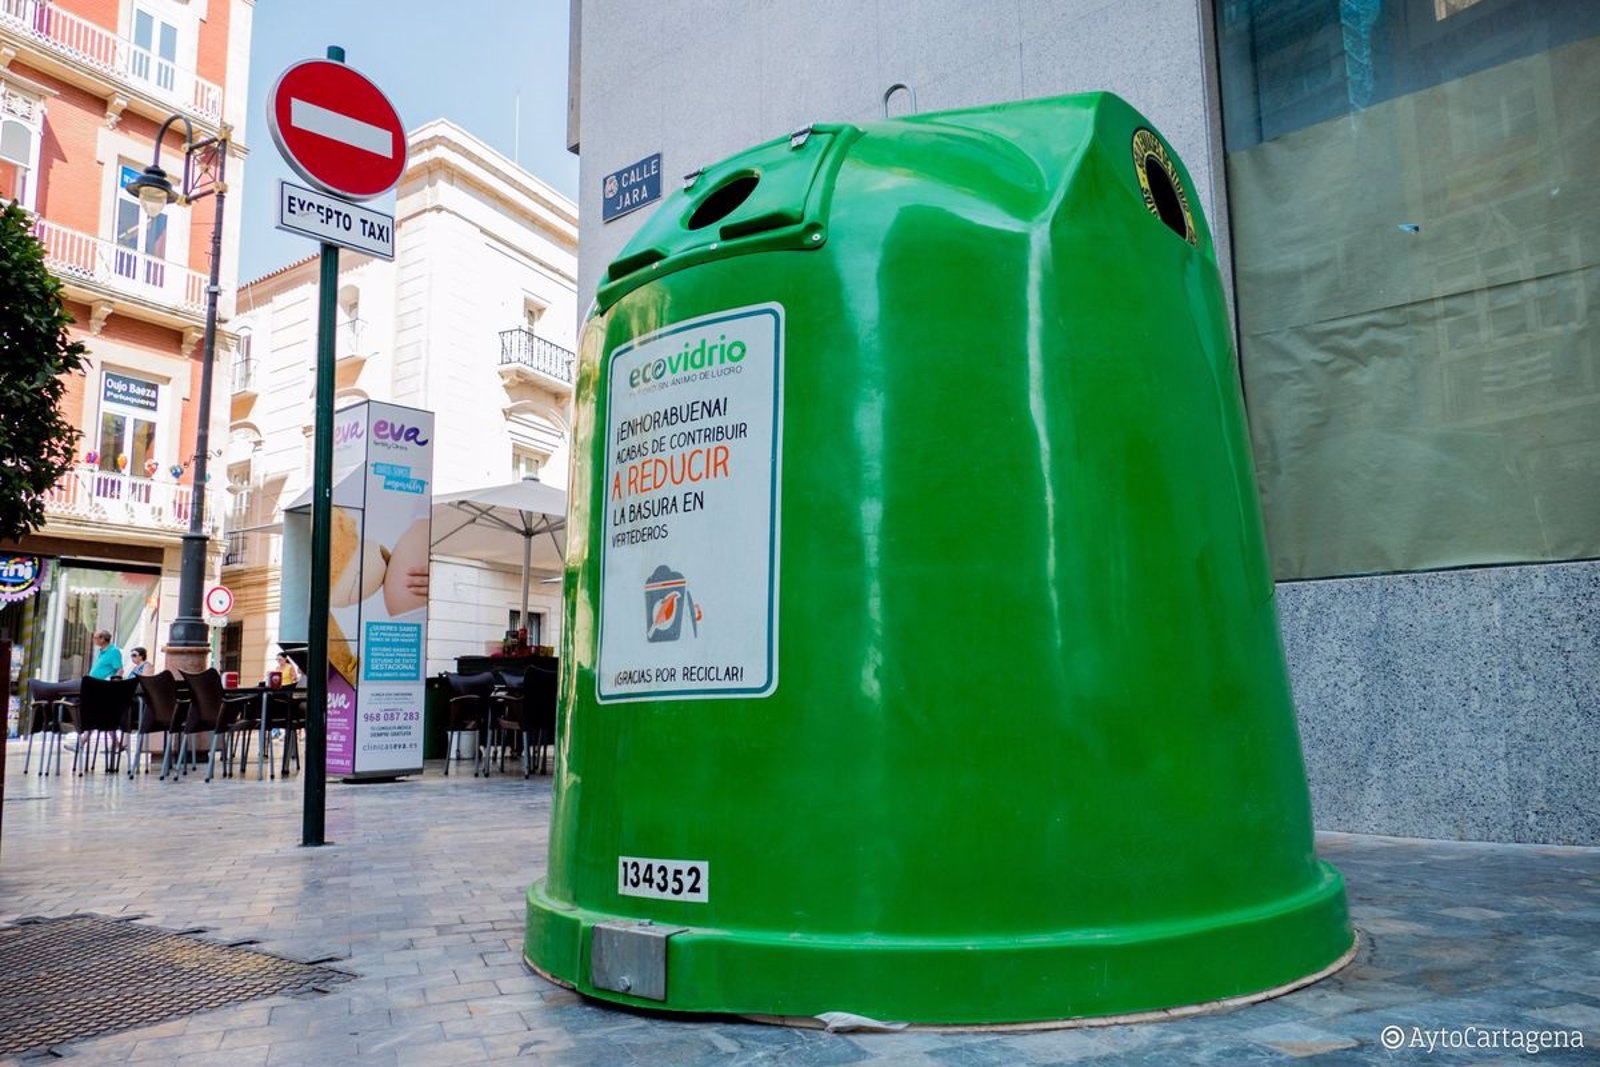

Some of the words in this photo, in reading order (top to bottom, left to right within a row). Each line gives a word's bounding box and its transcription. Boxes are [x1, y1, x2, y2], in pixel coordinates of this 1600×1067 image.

[622, 159, 658, 188] CALLE
[616, 184, 648, 210] JARA
[360, 218, 390, 243] TAXI
[629, 334, 747, 388] ecovidrio
[373, 420, 429, 446] eva
[615, 444, 650, 465] ACABAS
[651, 436, 667, 456] DE
[670, 422, 748, 449] CONTRIBUIR
[612, 469, 623, 502] A
[627, 445, 730, 497] REDUCIR
[612, 508, 626, 527] LA
[628, 495, 679, 524] BASURA
[683, 491, 704, 513] EN
[612, 523, 669, 549] VERTEDEROS
[614, 668, 653, 687] ¡GRACIAS
[655, 667, 677, 683] POR
[682, 666, 744, 682] RECICLAR!
[363, 712, 381, 722] 968
[403, 711, 420, 721] 283
[622, 861, 701, 896] 134352
